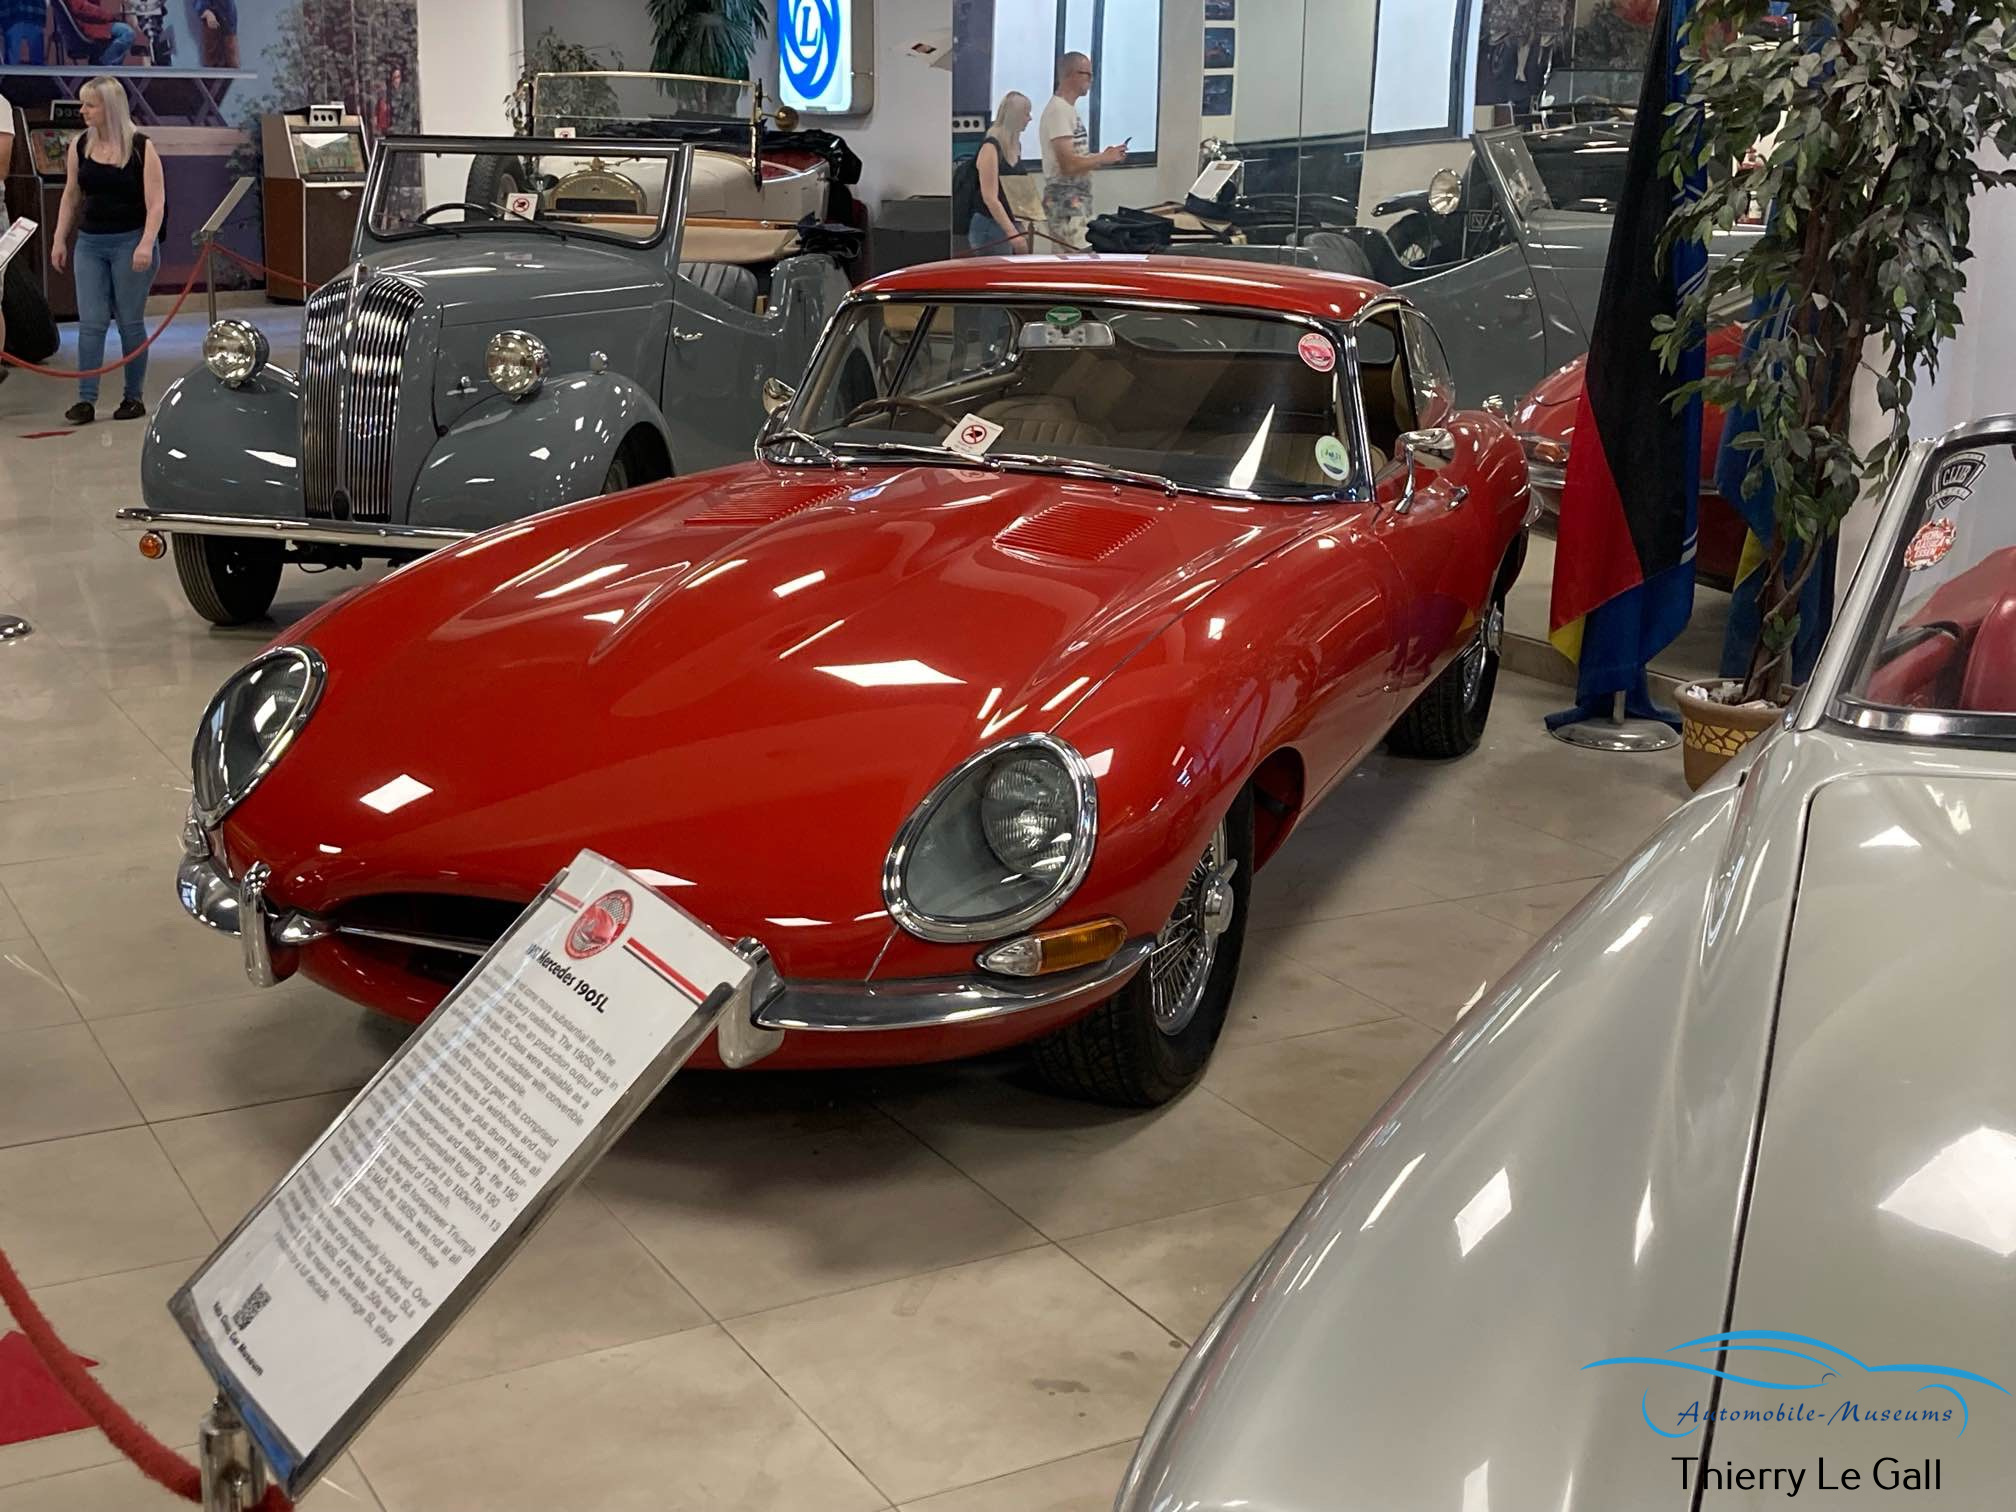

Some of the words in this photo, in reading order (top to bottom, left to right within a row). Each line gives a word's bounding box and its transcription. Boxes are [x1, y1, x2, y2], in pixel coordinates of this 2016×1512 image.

[800, 6, 818, 46] L
[1942, 464, 1972, 487] CLUB
[535, 948, 577, 986] Mercedes
[573, 979, 609, 1014] 190SL
[557, 1033, 575, 1050] The
[571, 1046, 598, 1070] 190SL
[585, 1038, 605, 1056] than
